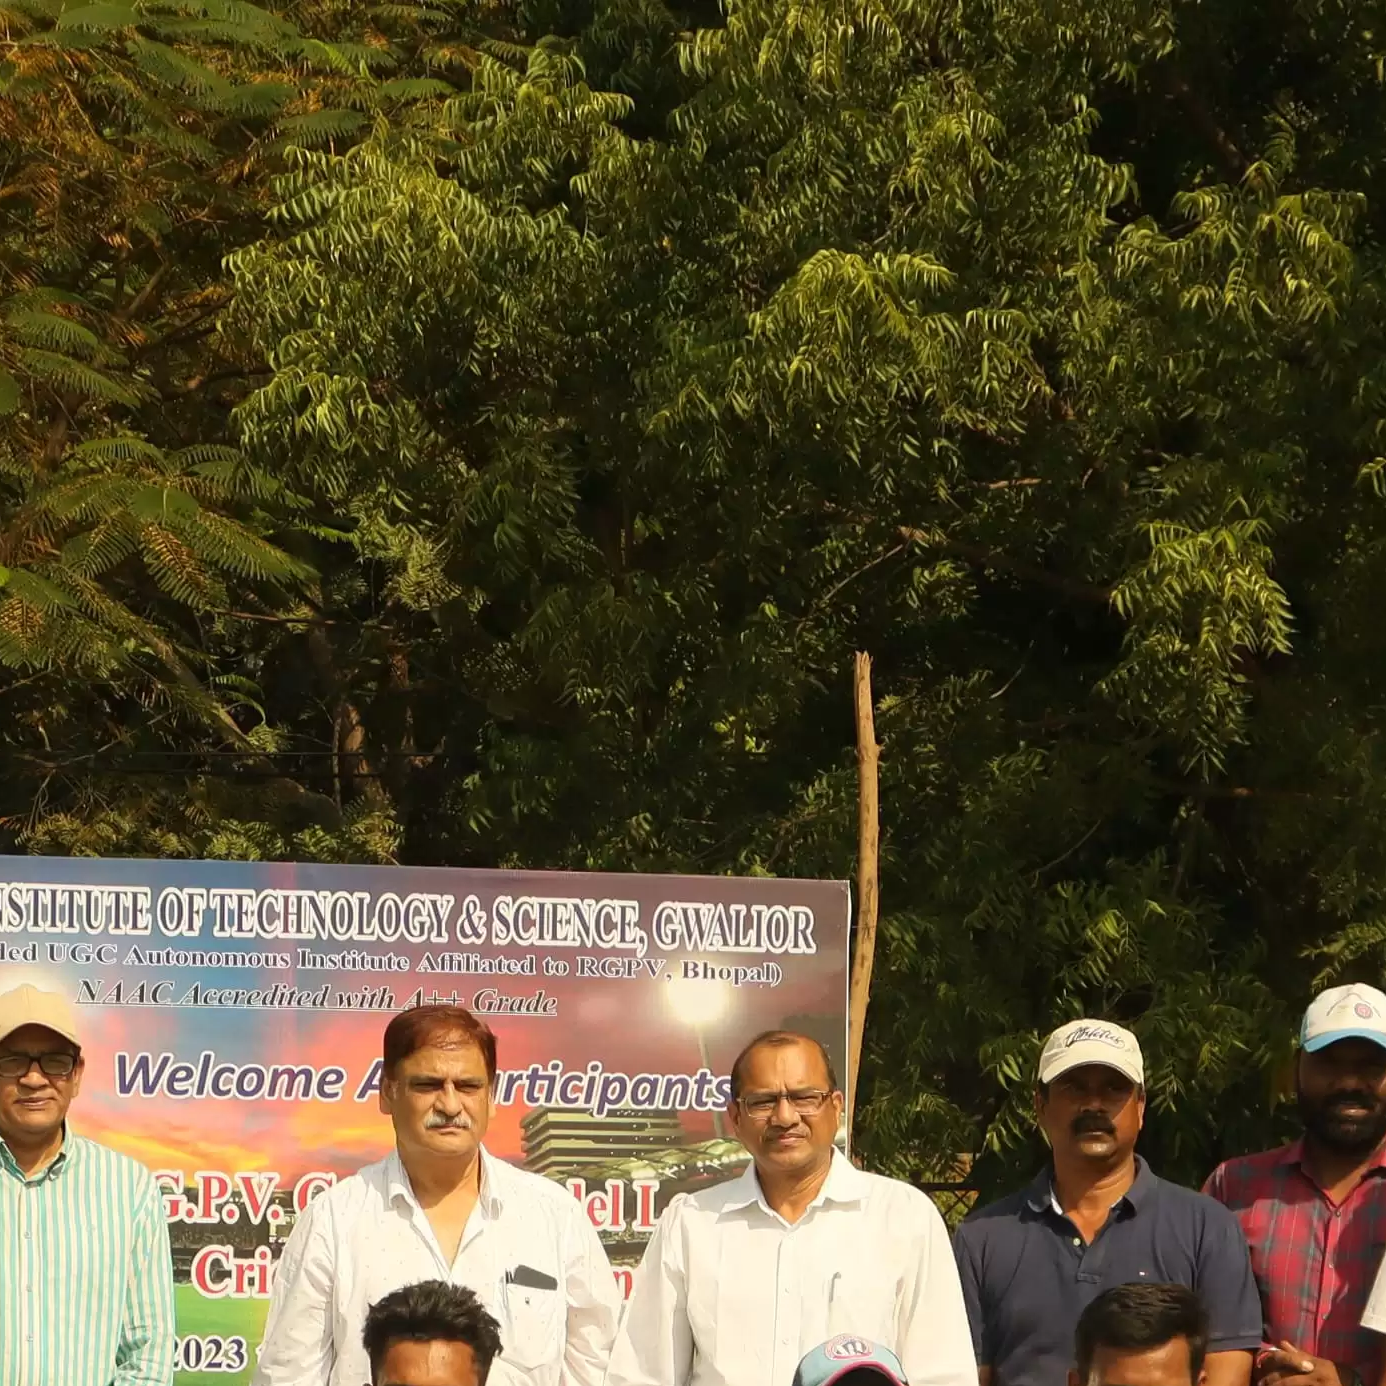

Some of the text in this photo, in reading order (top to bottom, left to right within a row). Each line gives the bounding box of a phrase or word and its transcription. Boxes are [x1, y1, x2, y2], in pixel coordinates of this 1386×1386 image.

[158, 887, 206, 937] OF
[213, 888, 454, 943] TECHNOLOGY
[457, 894, 485, 945] &
[493, 896, 647, 956] SCIENCE,
[653, 901, 816, 954] GWALIOR
[46, 943, 118, 966] UGC
[124, 945, 291, 969] Autonomous
[297, 948, 410, 973] Institute
[417, 951, 536, 976] Affiliated
[542, 956, 569, 977] to
[576, 956, 672, 981] RGPV,
[682, 960, 783, 986] Bhopal)
[76, 979, 558, 1015] NAAC Accredited with A++ Grade
[114, 1051, 347, 1102] Welcome
